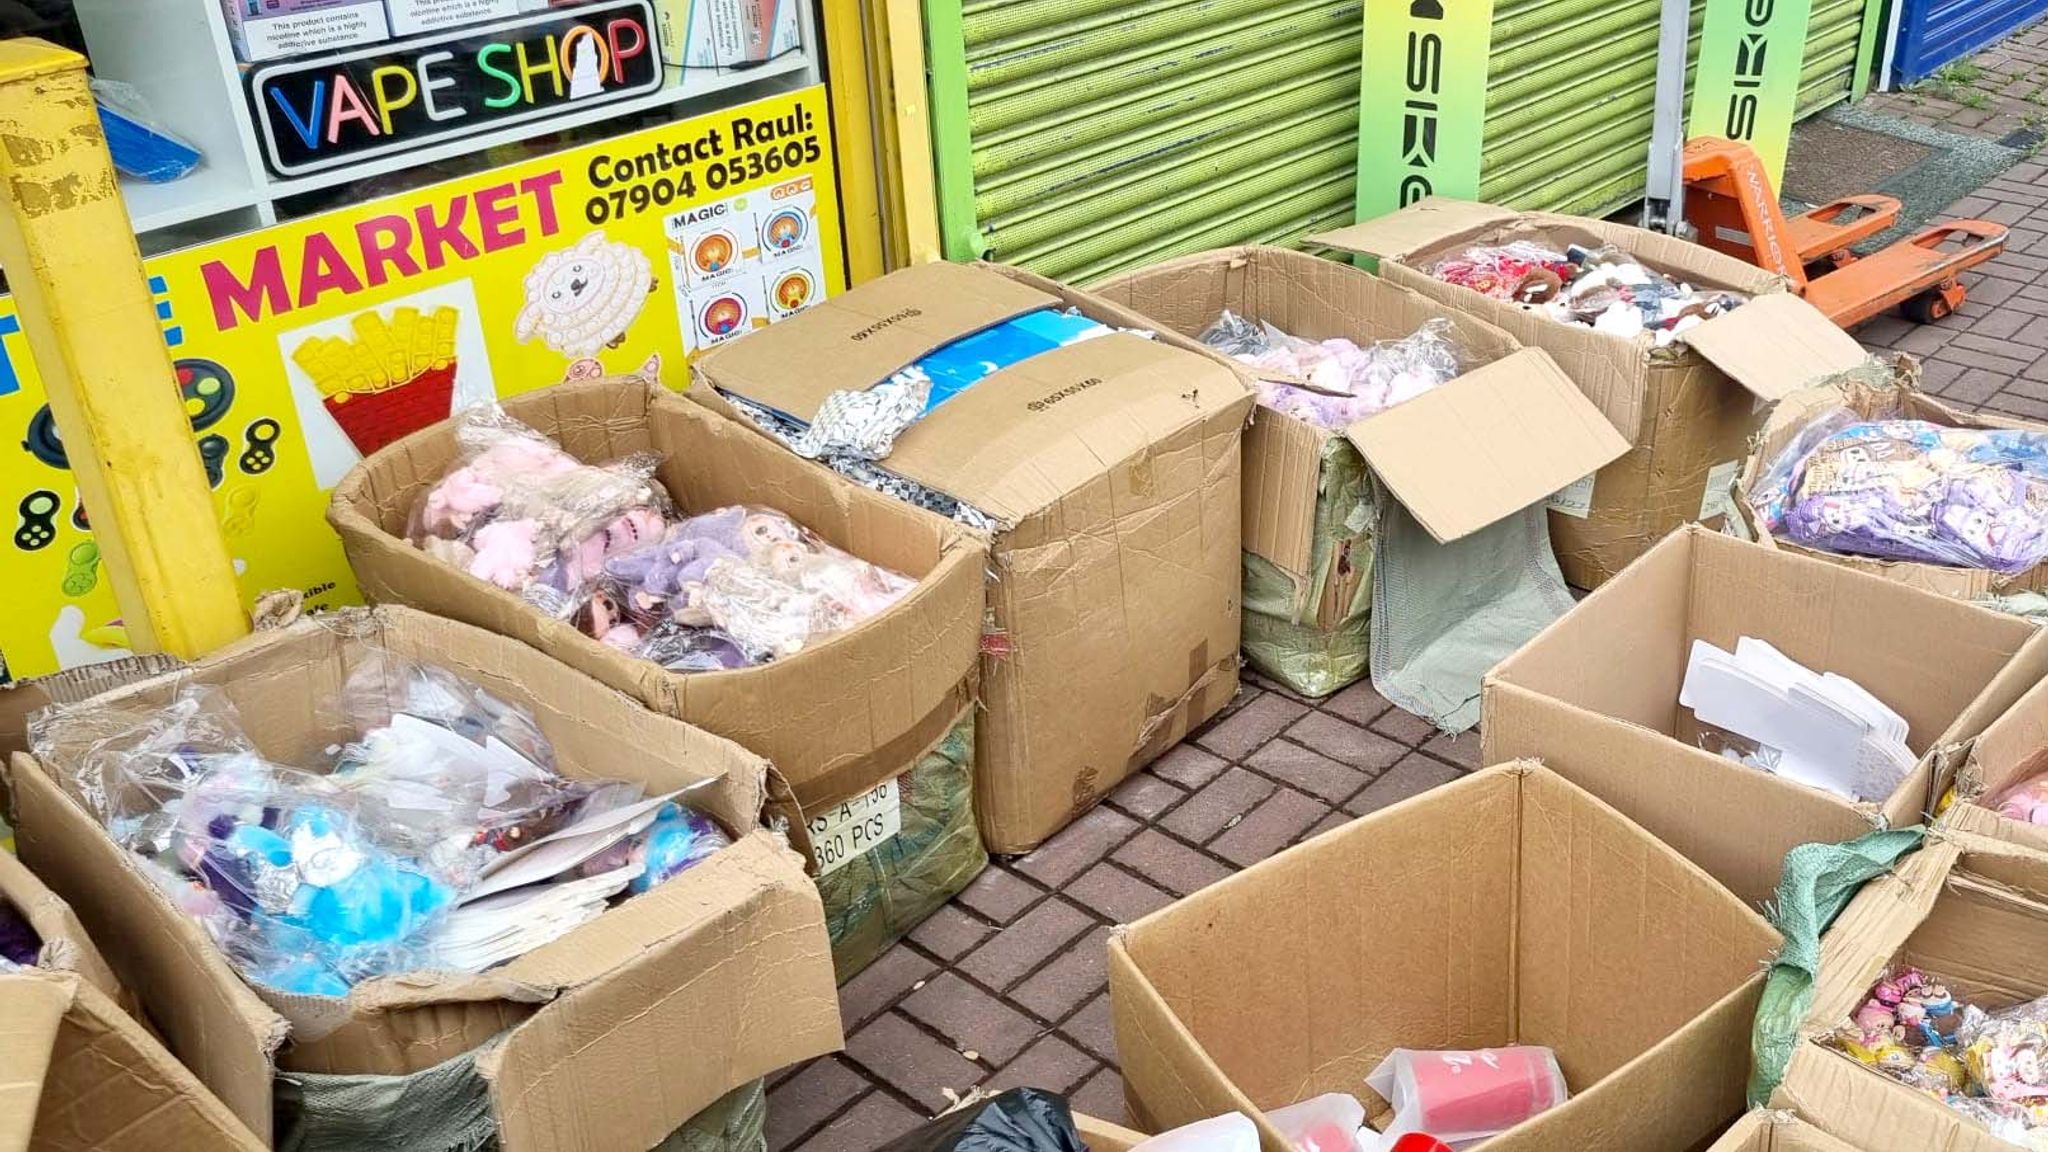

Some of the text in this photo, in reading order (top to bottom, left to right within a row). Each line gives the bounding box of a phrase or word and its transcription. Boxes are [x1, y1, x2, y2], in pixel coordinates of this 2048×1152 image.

[266, 31, 300, 41] nicotine
[303, 27, 326, 37] which
[344, 20, 367, 30] highly
[278, 40, 316, 50] addictive
[293, 17, 324, 29] product
[326, 12, 359, 23] contains
[270, 17, 646, 149] VAPE SHOP
[588, 102, 813, 188] Contact Raul:
[585, 171, 697, 225] 07904
[705, 136, 821, 191] 053605
[673, 204, 725, 229] MAGIC
[200, 169, 562, 332] MARKET
[814, 813, 884, 868] 360 PCS
